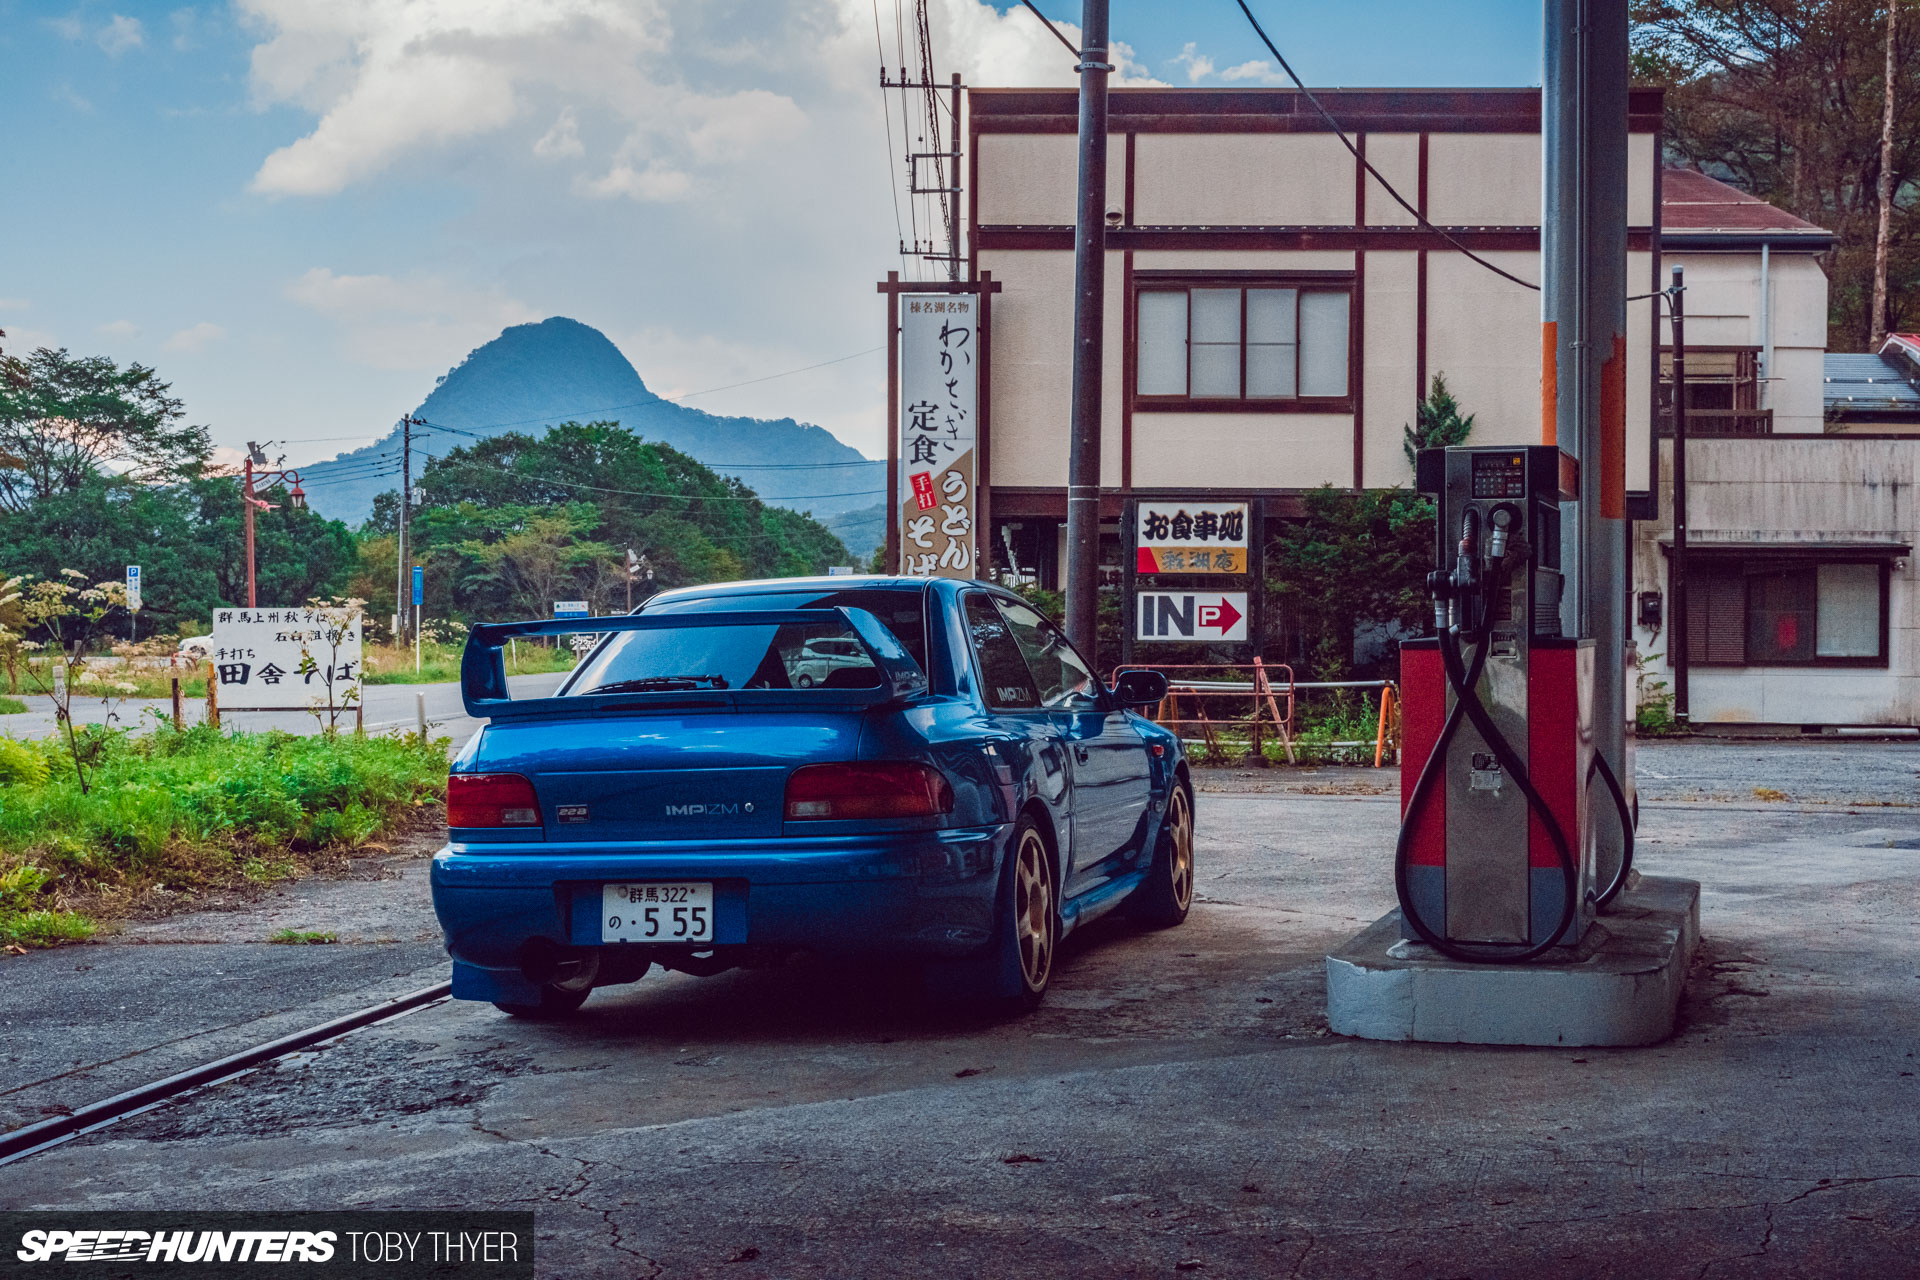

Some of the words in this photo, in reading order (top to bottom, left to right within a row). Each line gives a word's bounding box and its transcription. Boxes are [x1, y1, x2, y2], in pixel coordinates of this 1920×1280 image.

[910, 301, 969, 313] 榛名湖名物
[939, 318, 970, 452] わかさぎ
[908, 400, 939, 466] 定食
[915, 475, 934, 508] 手打
[940, 469, 971, 570] うどん
[1142, 509, 1244, 541] お食事処
[1143, 596, 1194, 636] IN
[1201, 607, 1221, 625] P
[215, 648, 256, 660] 手打ち
[218, 660, 359, 685] 田舎そば
